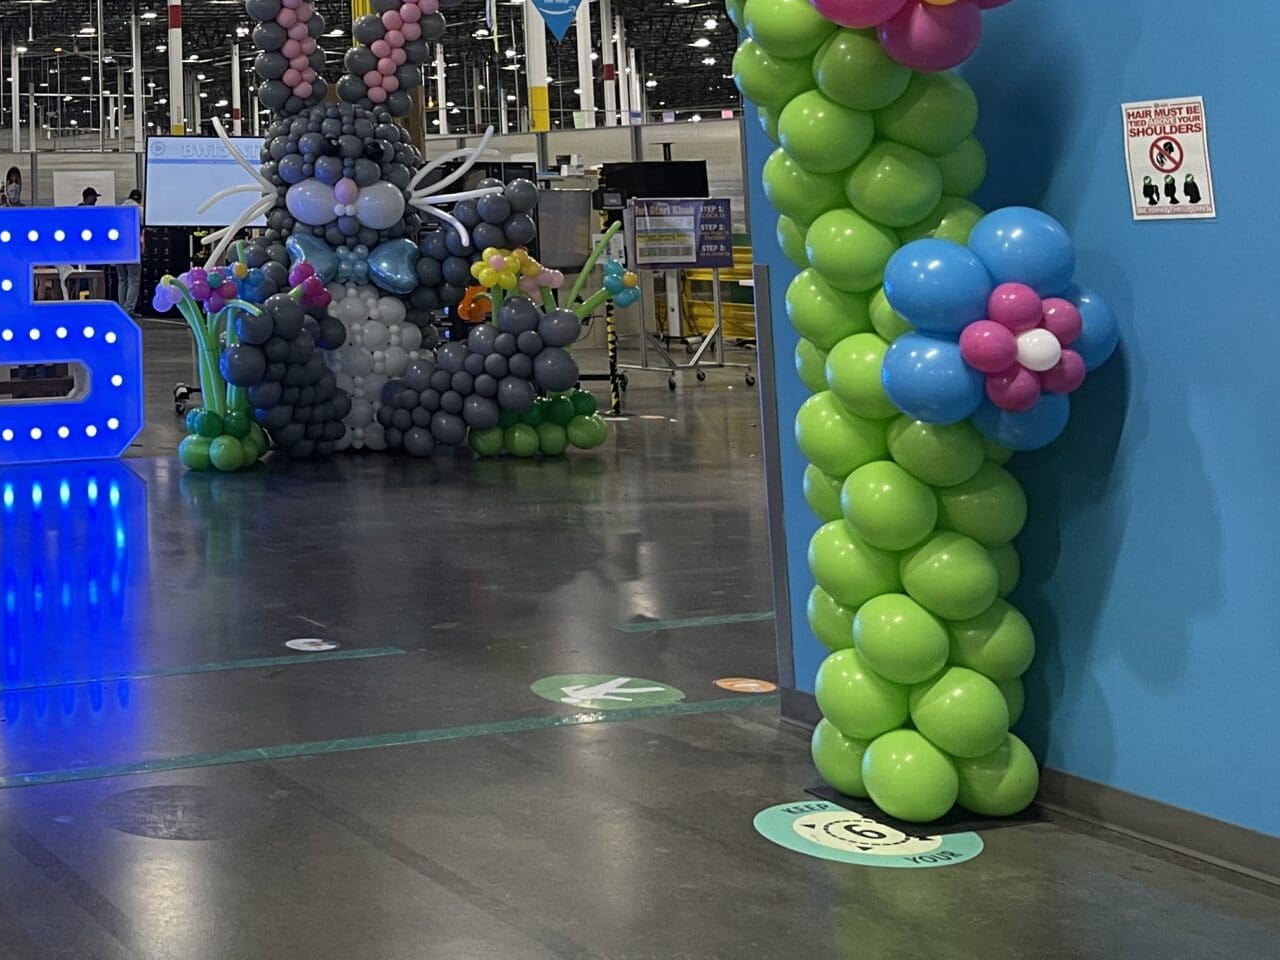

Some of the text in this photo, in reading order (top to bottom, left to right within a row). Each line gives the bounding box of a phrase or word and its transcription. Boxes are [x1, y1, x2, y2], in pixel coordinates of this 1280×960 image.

[1127, 105, 1200, 120] HAIR MUST BE
[1177, 115, 1201, 124] YOUR
[1129, 123, 1202, 137] SHOULDERS
[781, 803, 829, 814] KEEP
[903, 851, 963, 864] YOUR
